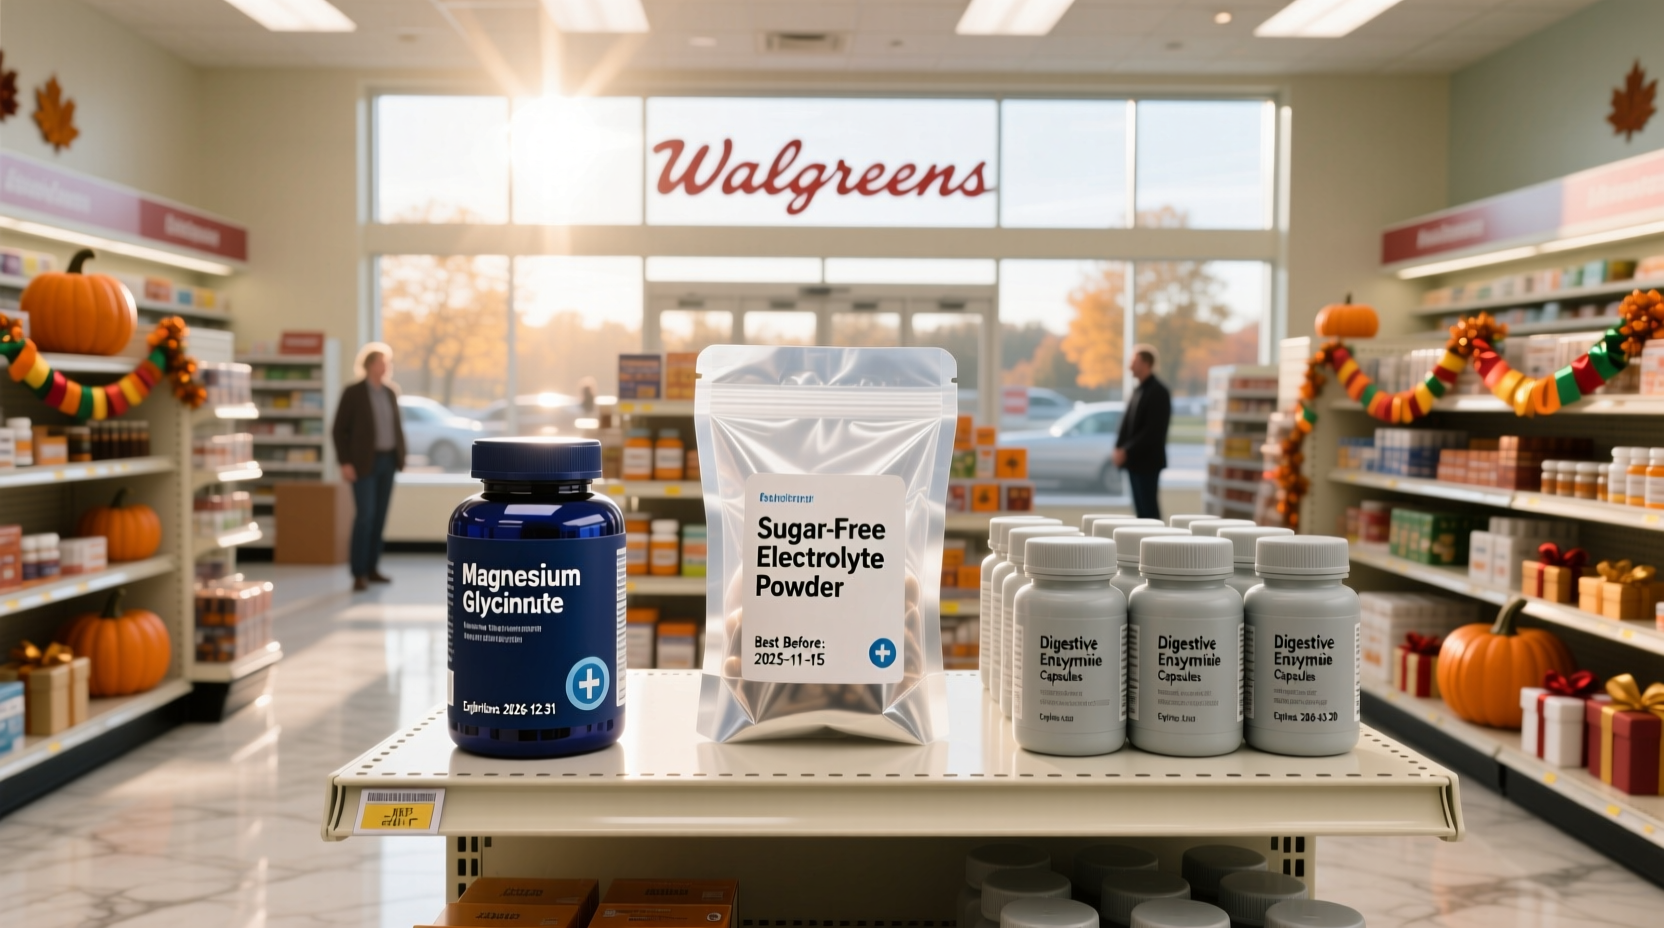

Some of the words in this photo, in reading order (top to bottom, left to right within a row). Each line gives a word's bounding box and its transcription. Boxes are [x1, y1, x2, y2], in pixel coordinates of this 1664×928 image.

[653, 138, 997, 215] Walgreens
[757, 516, 886, 545] Sugar-Free
[757, 545, 885, 574] Electrolyte
[462, 562, 582, 593] Magnesium
[756, 574, 845, 598] Powder
[755, 635, 779, 649] Best
[783, 636, 825, 649] Before:
[1040, 635, 1098, 654] Digestive
[1158, 635, 1217, 654] Digestive
[1274, 633, 1335, 653] Digestive
[754, 652, 825, 666] 2025-11-15
